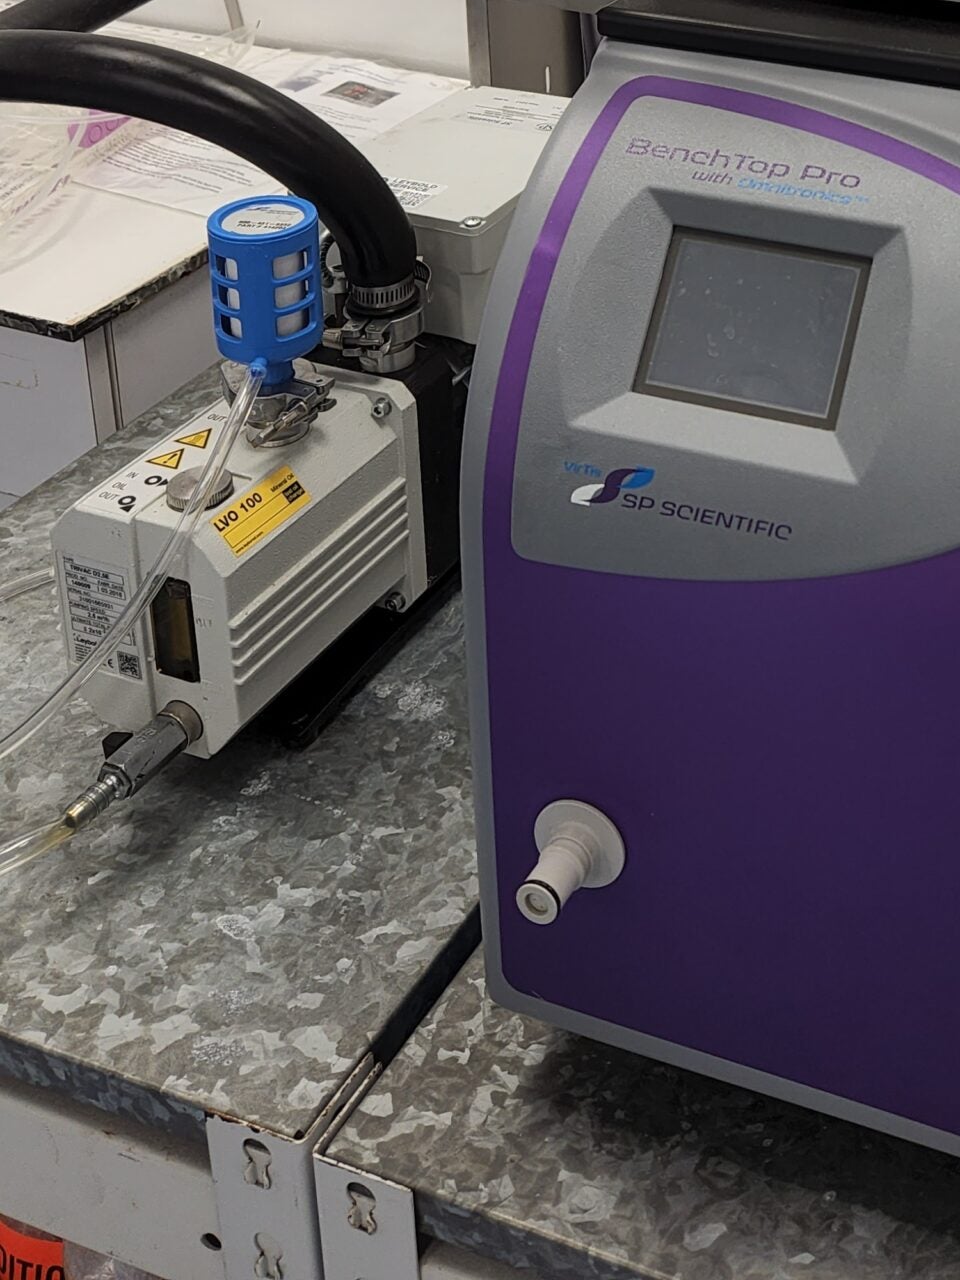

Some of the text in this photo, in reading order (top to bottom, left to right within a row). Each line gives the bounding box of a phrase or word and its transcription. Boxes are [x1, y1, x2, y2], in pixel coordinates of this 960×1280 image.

[625, 136, 861, 189] BenchTop Pro
[692, 170, 732, 185] with
[126, 471, 139, 479] IN
[99, 491, 119, 500] OUT
[213, 510, 239, 532] LVO
[239, 492, 263, 513] 100
[621, 493, 793, 541] SP SCIENTIFIC
